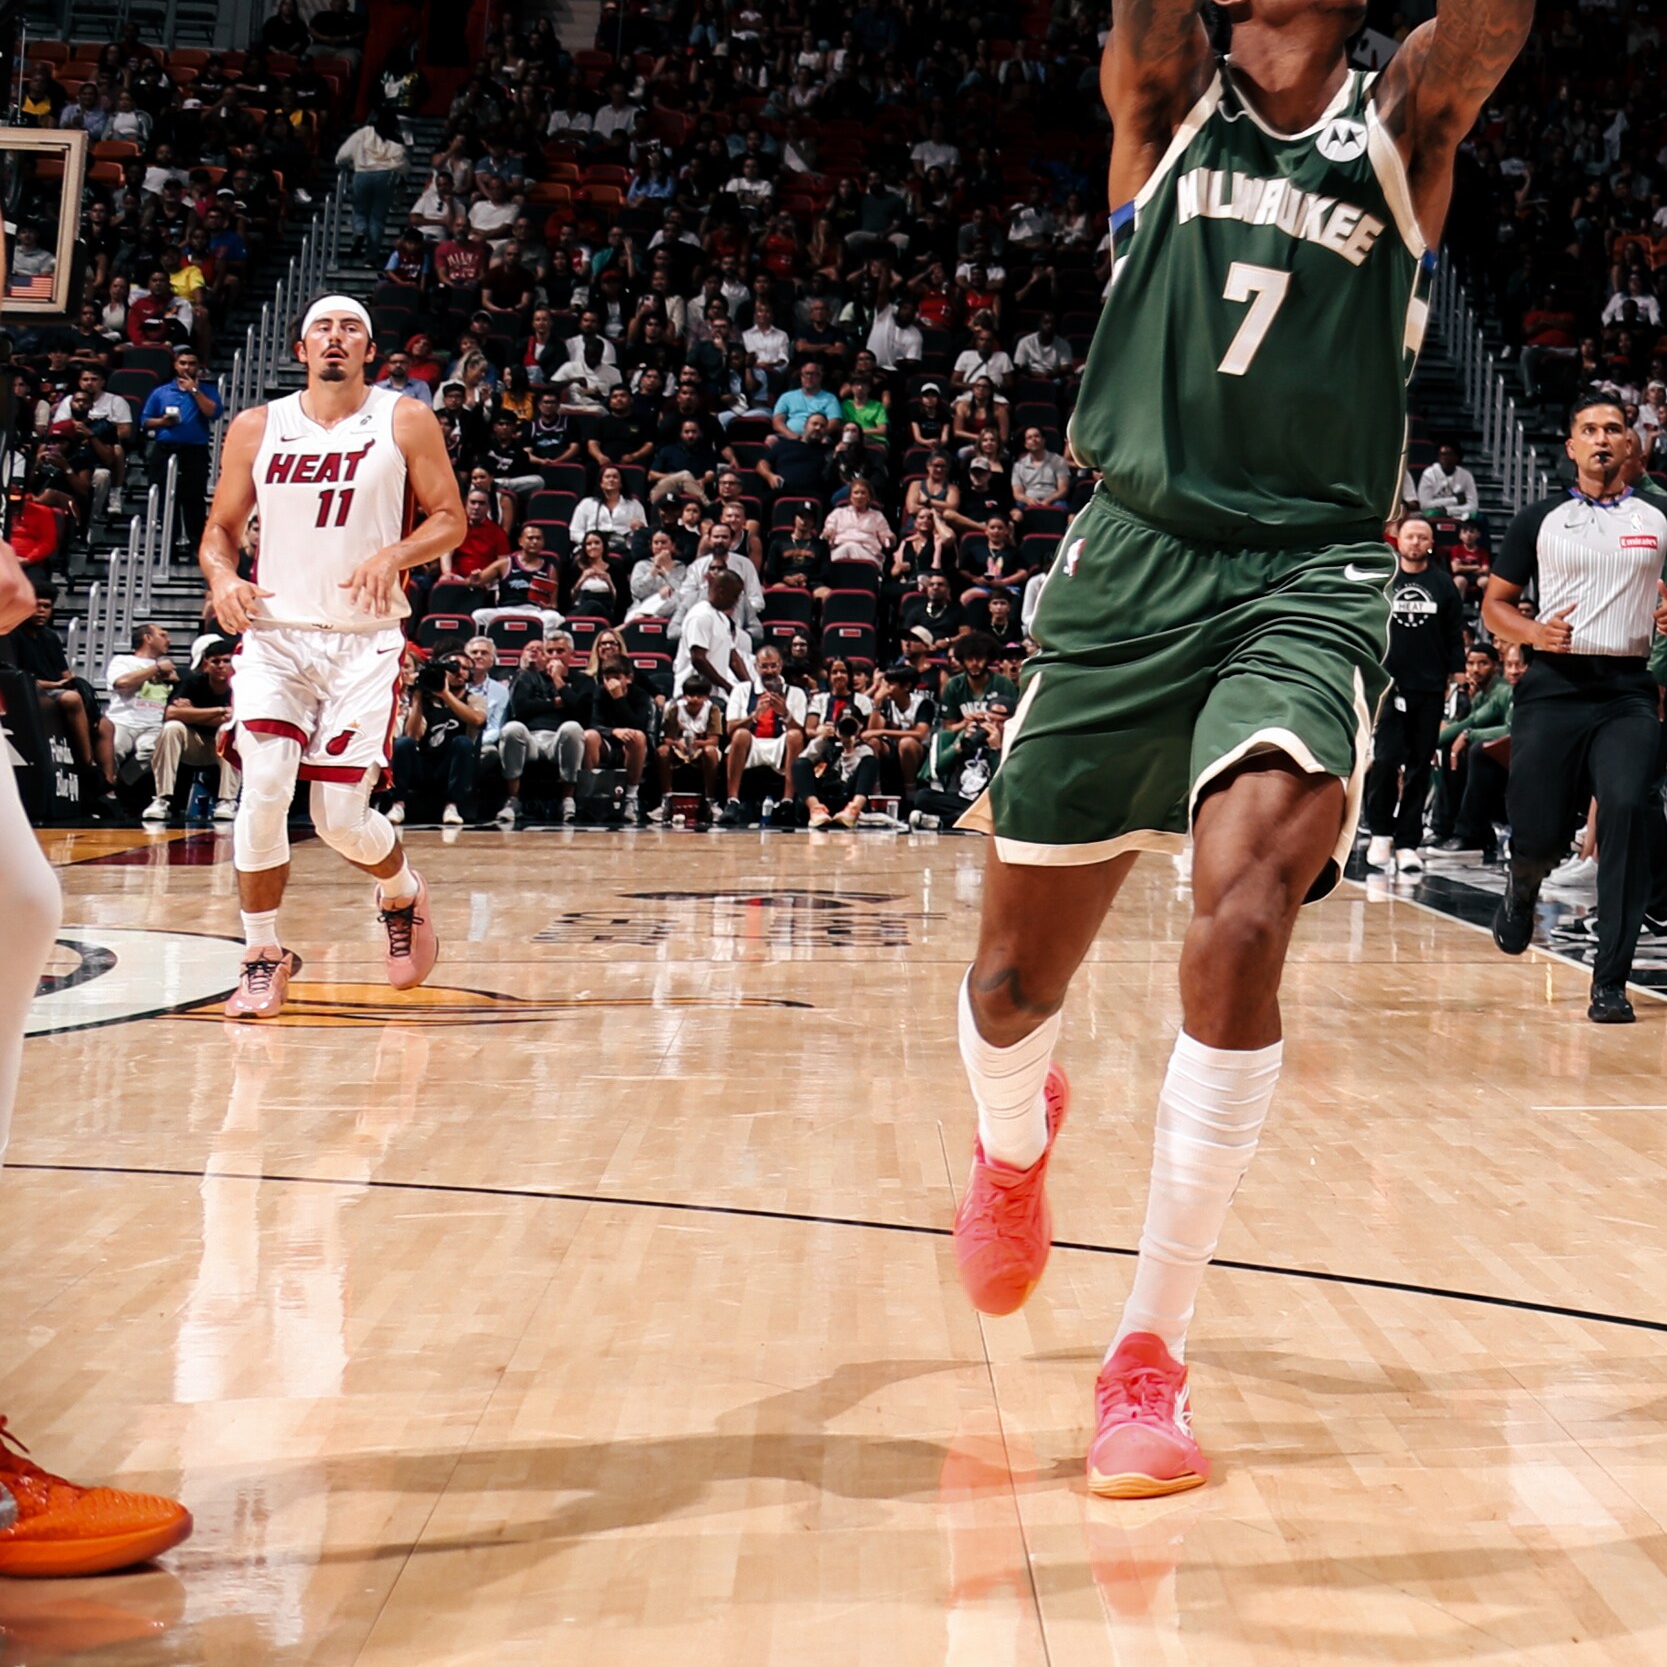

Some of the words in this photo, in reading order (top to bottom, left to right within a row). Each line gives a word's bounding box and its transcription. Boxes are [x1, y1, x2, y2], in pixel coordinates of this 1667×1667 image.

[1176, 166, 1389, 268] MILWAUKEE
[1216, 260, 1294, 377] 7
[265, 438, 376, 484] HEAT
[315, 488, 355, 528] 11
